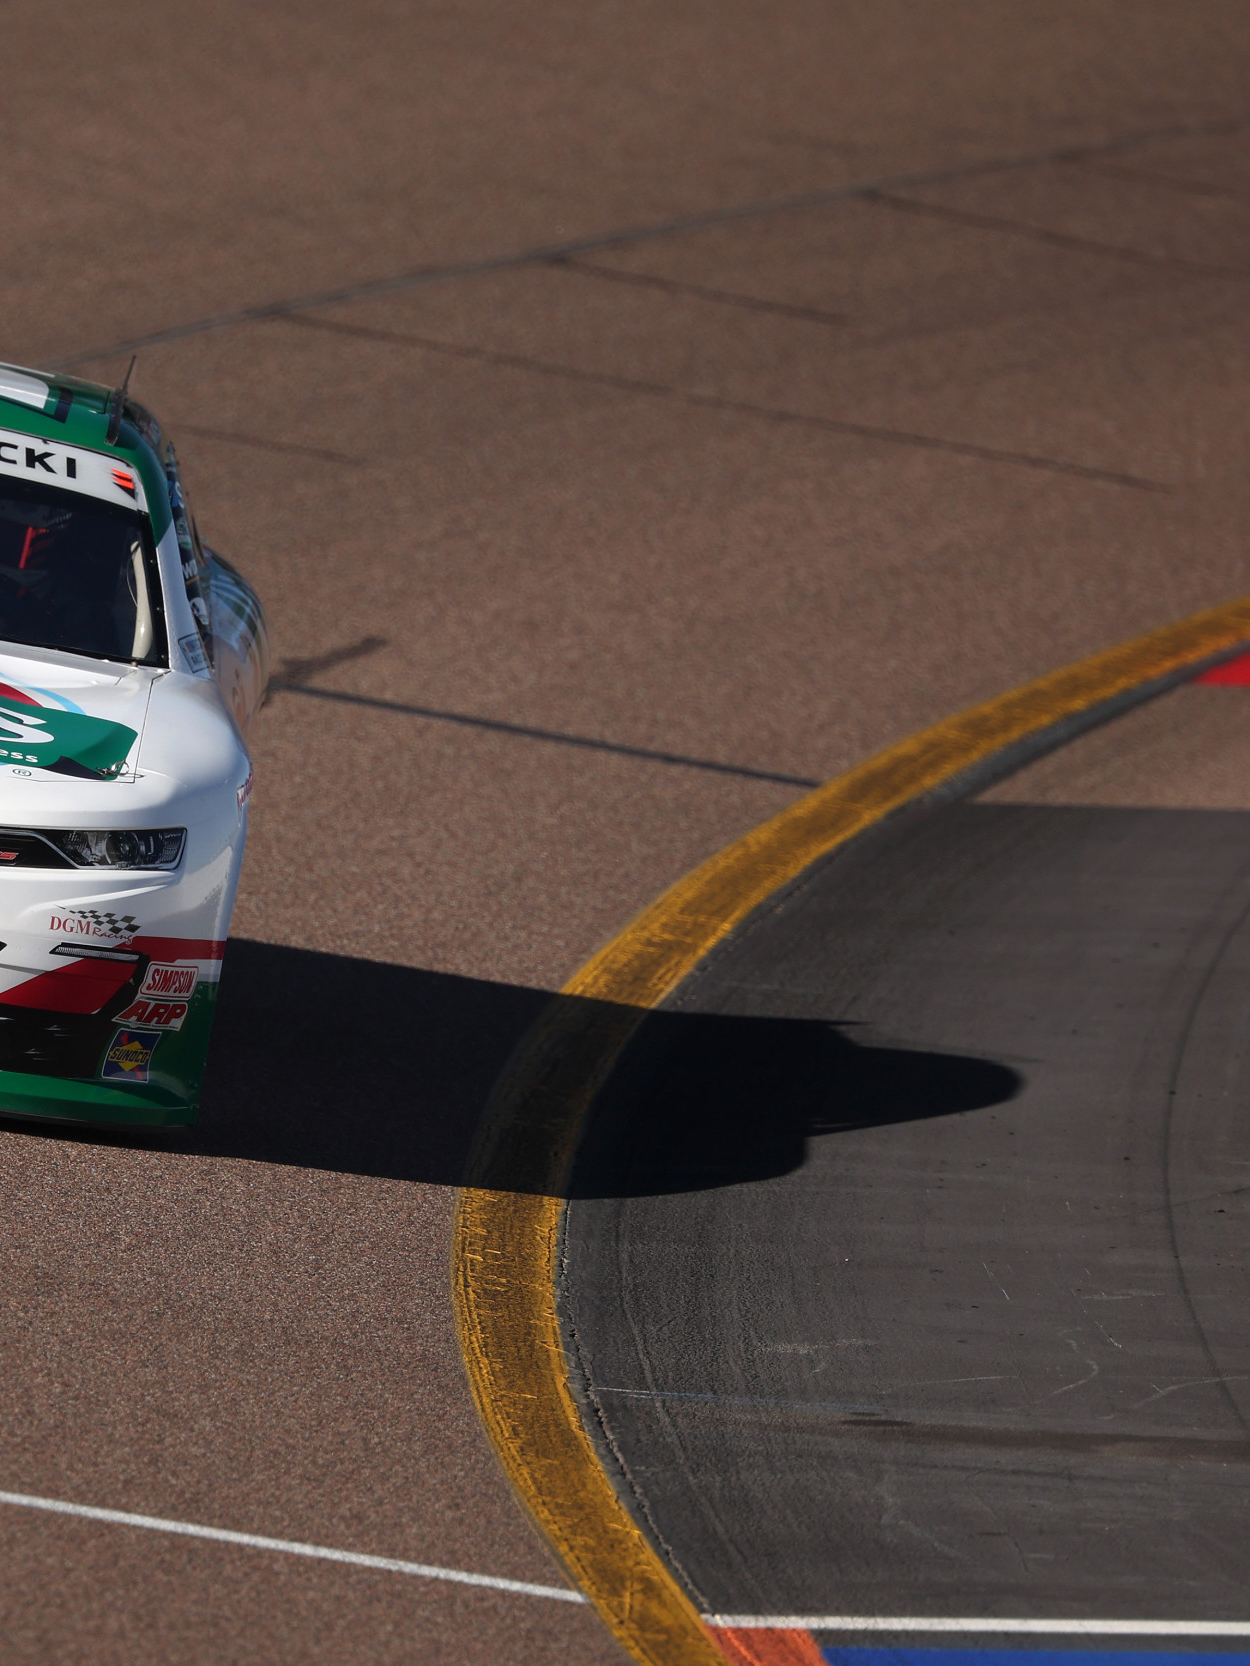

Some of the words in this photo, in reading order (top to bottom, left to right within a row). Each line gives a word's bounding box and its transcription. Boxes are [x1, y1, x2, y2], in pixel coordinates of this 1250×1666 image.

[49, 915, 92, 935] DGM
[92, 927, 134, 945] Racing
[145, 968, 196, 995] SIMPSON
[116, 1000, 187, 1025] ARP
[110, 1048, 150, 1064] SUNOCO
